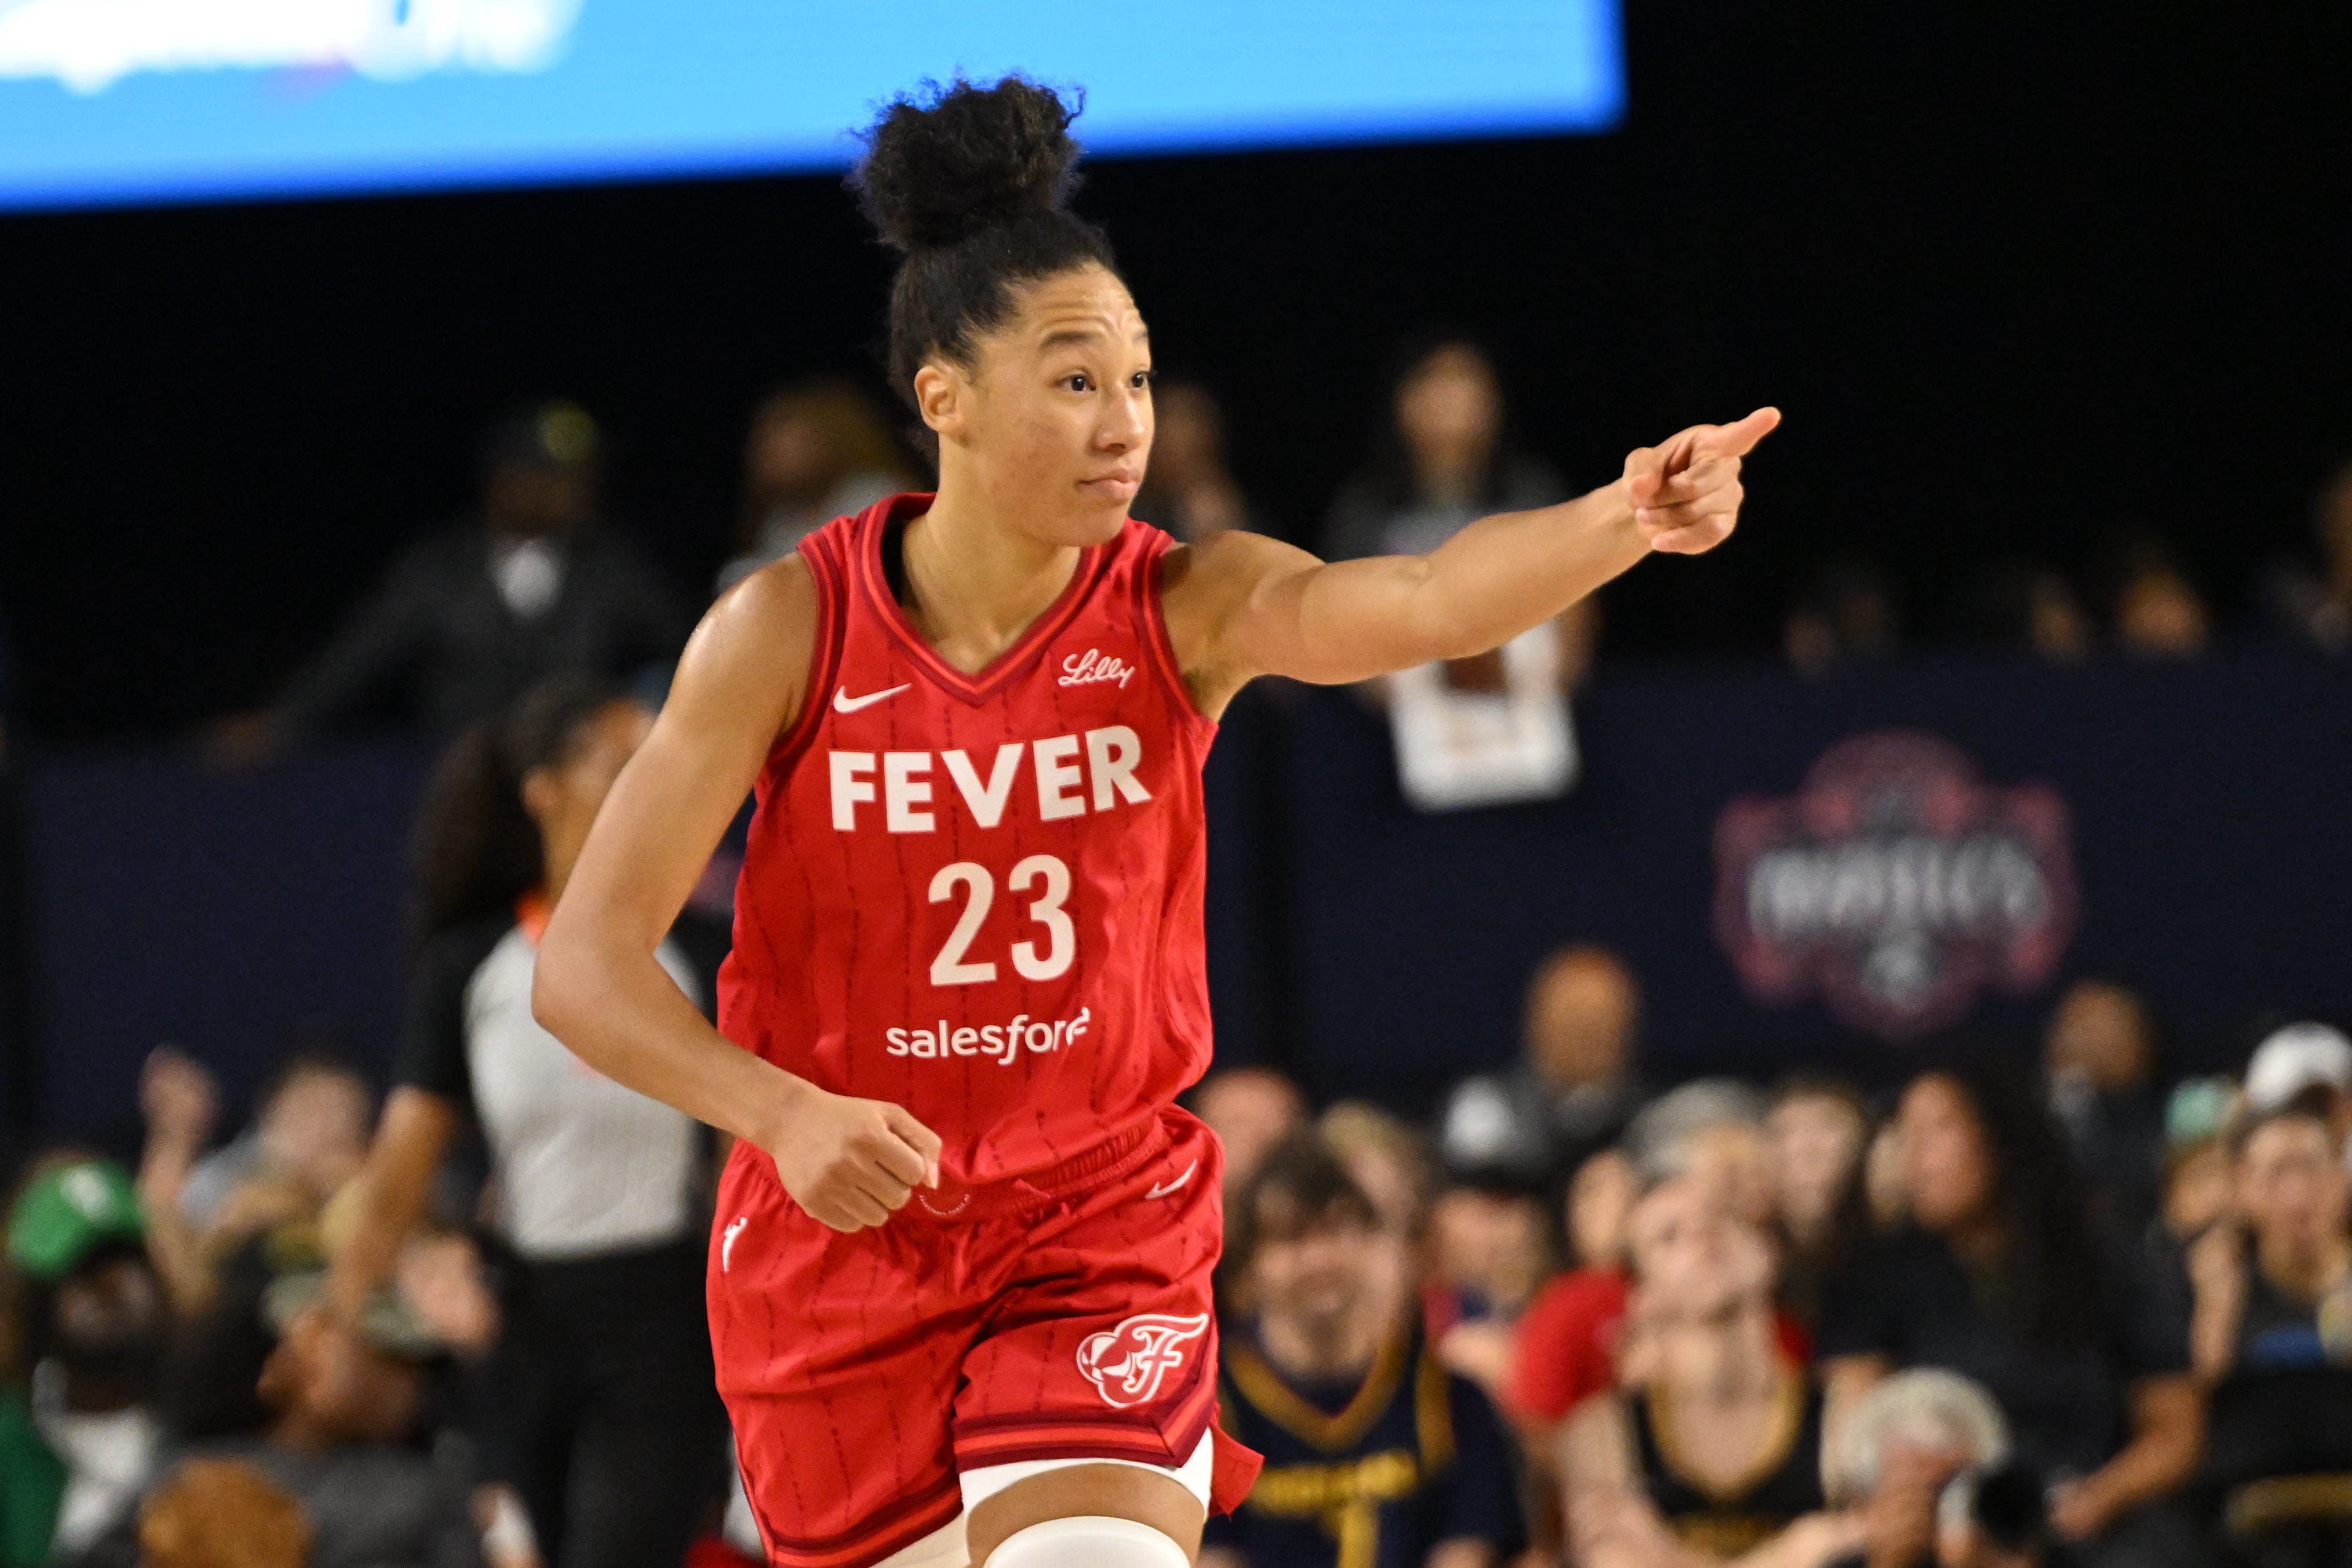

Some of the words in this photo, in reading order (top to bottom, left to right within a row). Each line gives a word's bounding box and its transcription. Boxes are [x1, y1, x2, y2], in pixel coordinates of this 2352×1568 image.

[1058, 648, 1135, 688] Lilly
[828, 725, 1151, 833] FEVER
[928, 854, 1075, 986] 23
